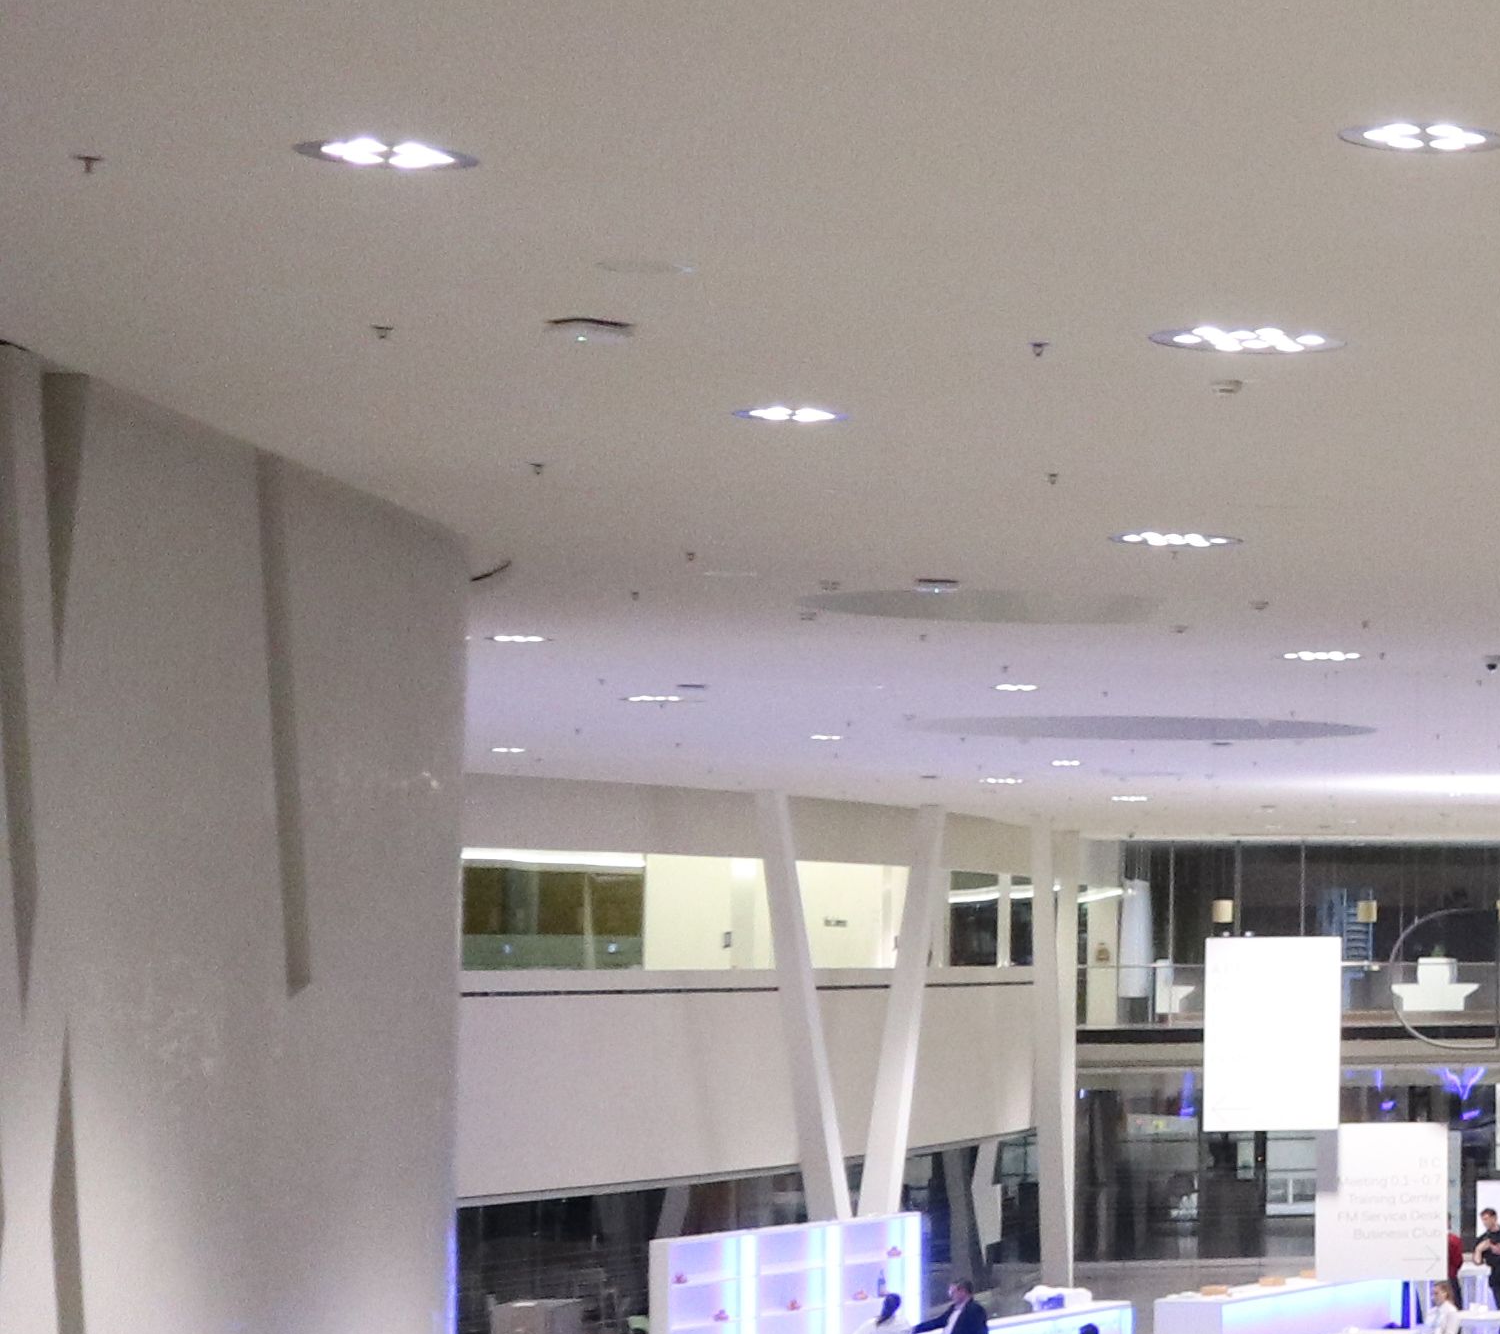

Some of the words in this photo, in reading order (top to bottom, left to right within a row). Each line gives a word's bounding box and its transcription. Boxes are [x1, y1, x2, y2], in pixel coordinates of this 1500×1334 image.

[1348, 1192, 1396, 1206] Training
[1399, 1192, 1441, 1204] Center
[1361, 1209, 1407, 1222] Service
[1410, 1209, 1442, 1221] Desk
[1352, 1227, 1409, 1241] Business
[1411, 1226, 1442, 1239] Club
